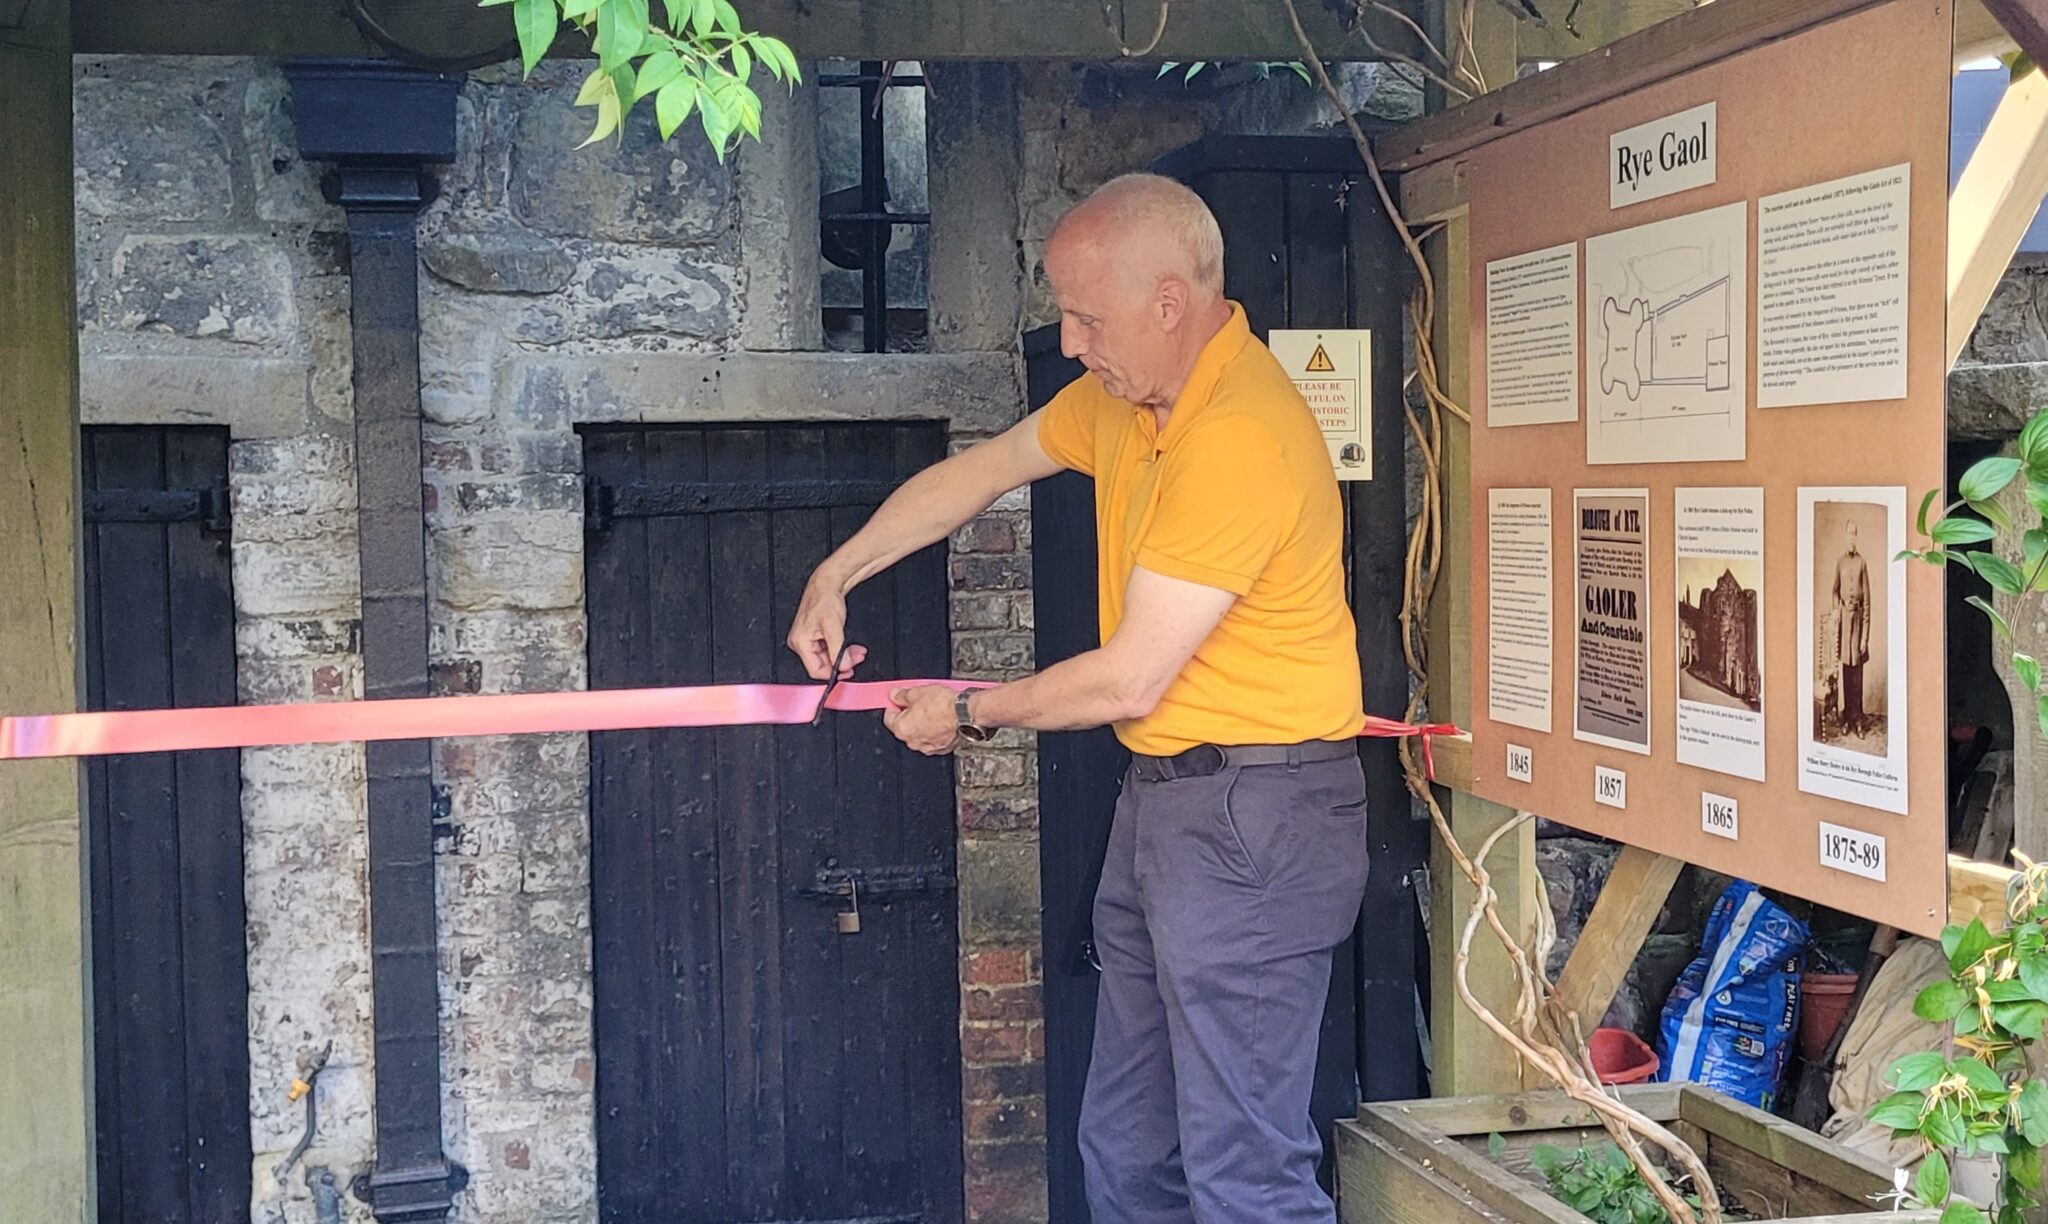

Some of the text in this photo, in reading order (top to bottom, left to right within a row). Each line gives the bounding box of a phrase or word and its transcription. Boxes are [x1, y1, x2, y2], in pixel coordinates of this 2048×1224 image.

[1617, 120, 1708, 192] Rye Gaol
[1304, 394, 1347, 403] EFUL ON
[1330, 383, 1342, 391] BE
[1312, 406, 1350, 415] ISTORIC
[1319, 418, 1347, 427] STEPS
[1585, 584, 1638, 621] GAOLER
[1581, 618, 1643, 644] And Constable
[1509, 752, 1529, 774] 1845
[1599, 775, 1622, 799] 1857
[1706, 802, 1734, 830] 1865
[1824, 832, 1881, 870] 1875-89
